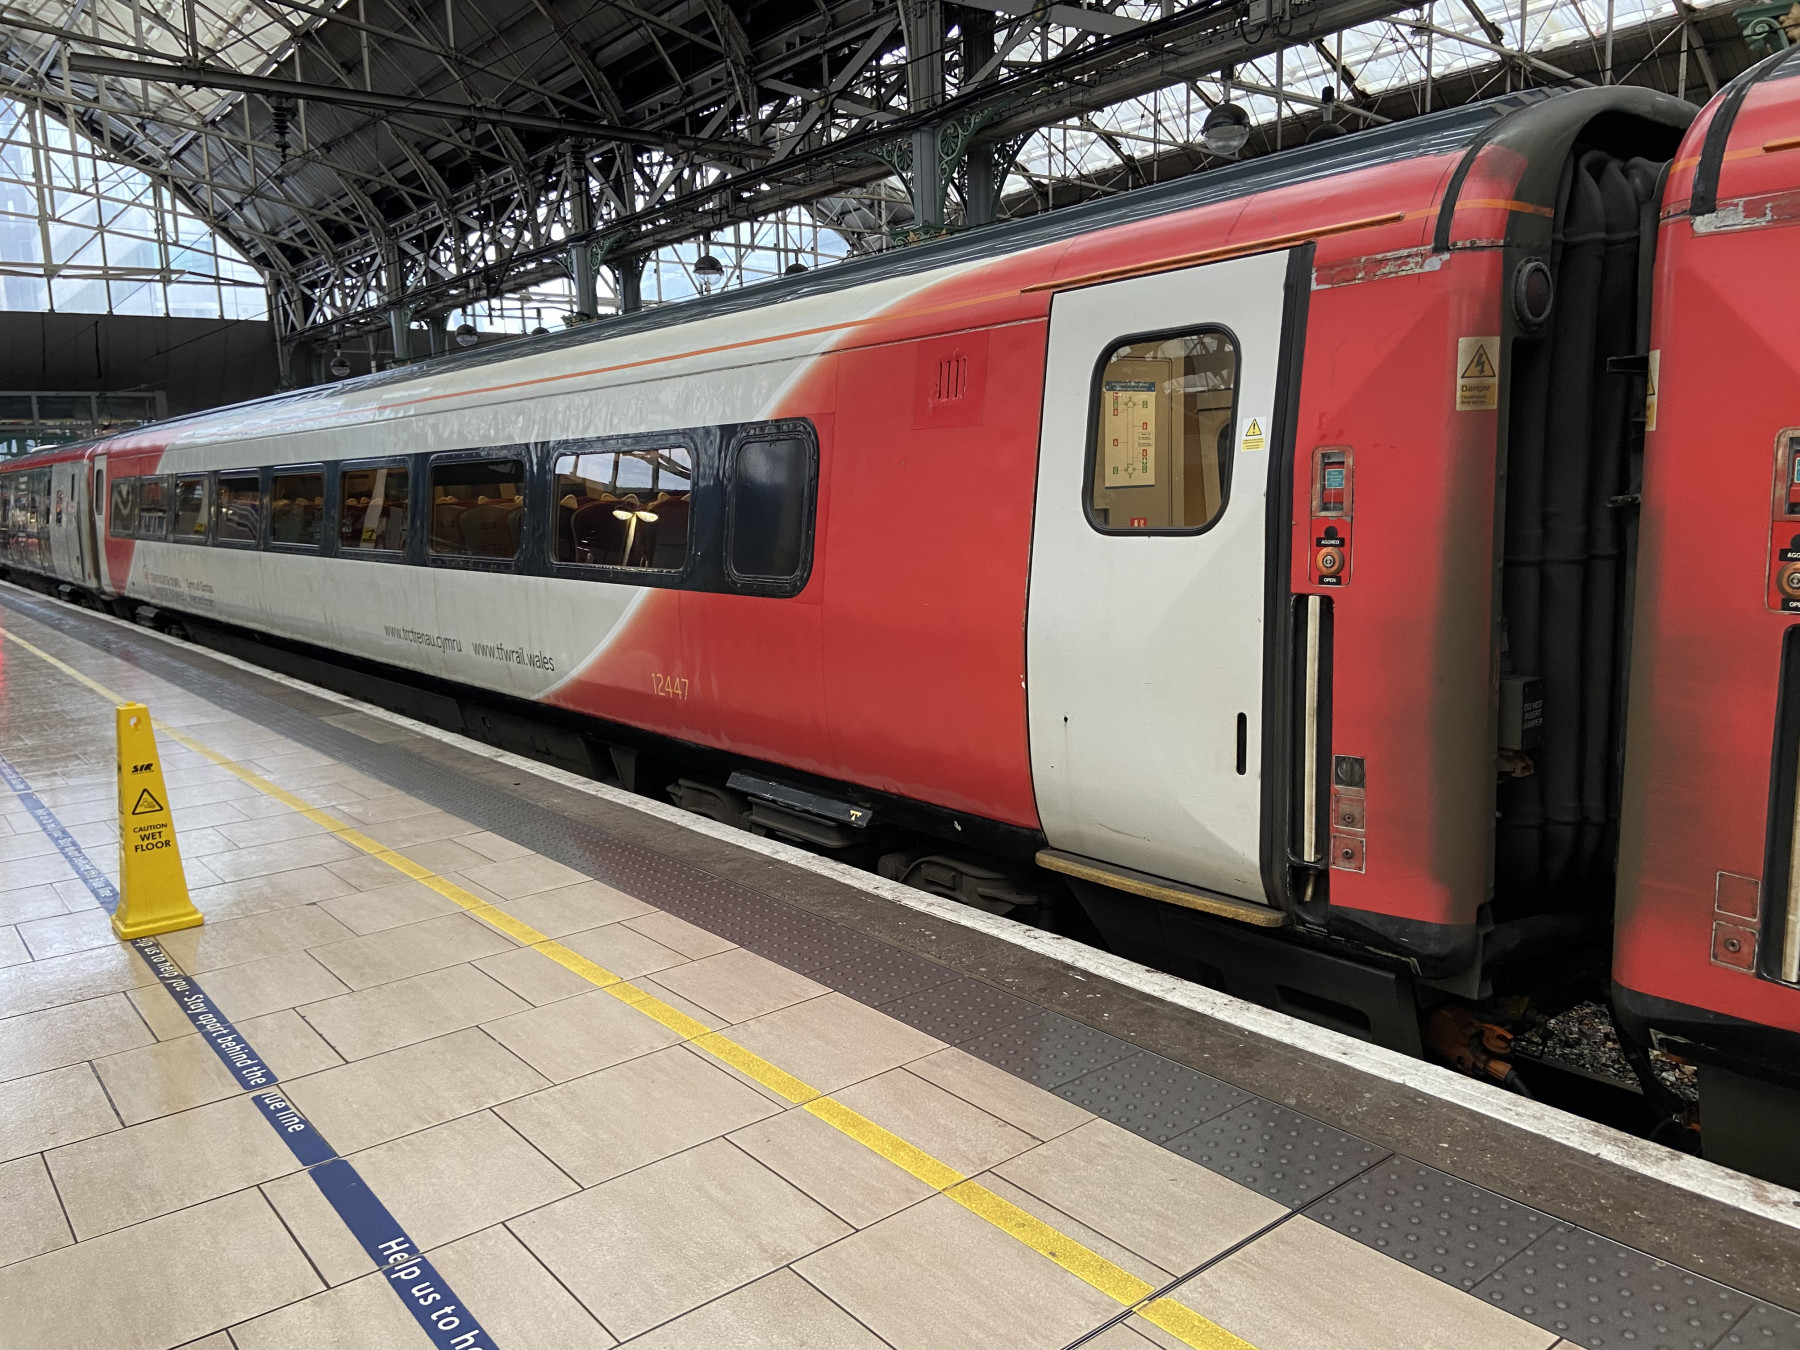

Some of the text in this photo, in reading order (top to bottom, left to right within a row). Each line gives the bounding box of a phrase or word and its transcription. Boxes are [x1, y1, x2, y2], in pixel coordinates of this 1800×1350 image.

[1461, 384, 1491, 393] Danger
[384, 625, 555, 672] www.trctrenau.cymru www.tfwrail.wales
[650, 672, 689, 700] 12447
[131, 763, 154, 773] SIR
[133, 823, 168, 833] CAUTION
[139, 831, 163, 841] WET
[134, 840, 171, 853] FLOOR
[144, 946, 160, 955] us
[150, 953, 166, 963] to
[165, 978, 190, 991] you
[184, 994, 208, 1014] Stay
[196, 1013, 230, 1037] apart
[217, 1034, 259, 1068] behind
[242, 1066, 267, 1086] the
[276, 1109, 305, 1133] line
[378, 1237, 422, 1280] Help
[411, 1281, 441, 1306] us
[430, 1305, 460, 1331] to
